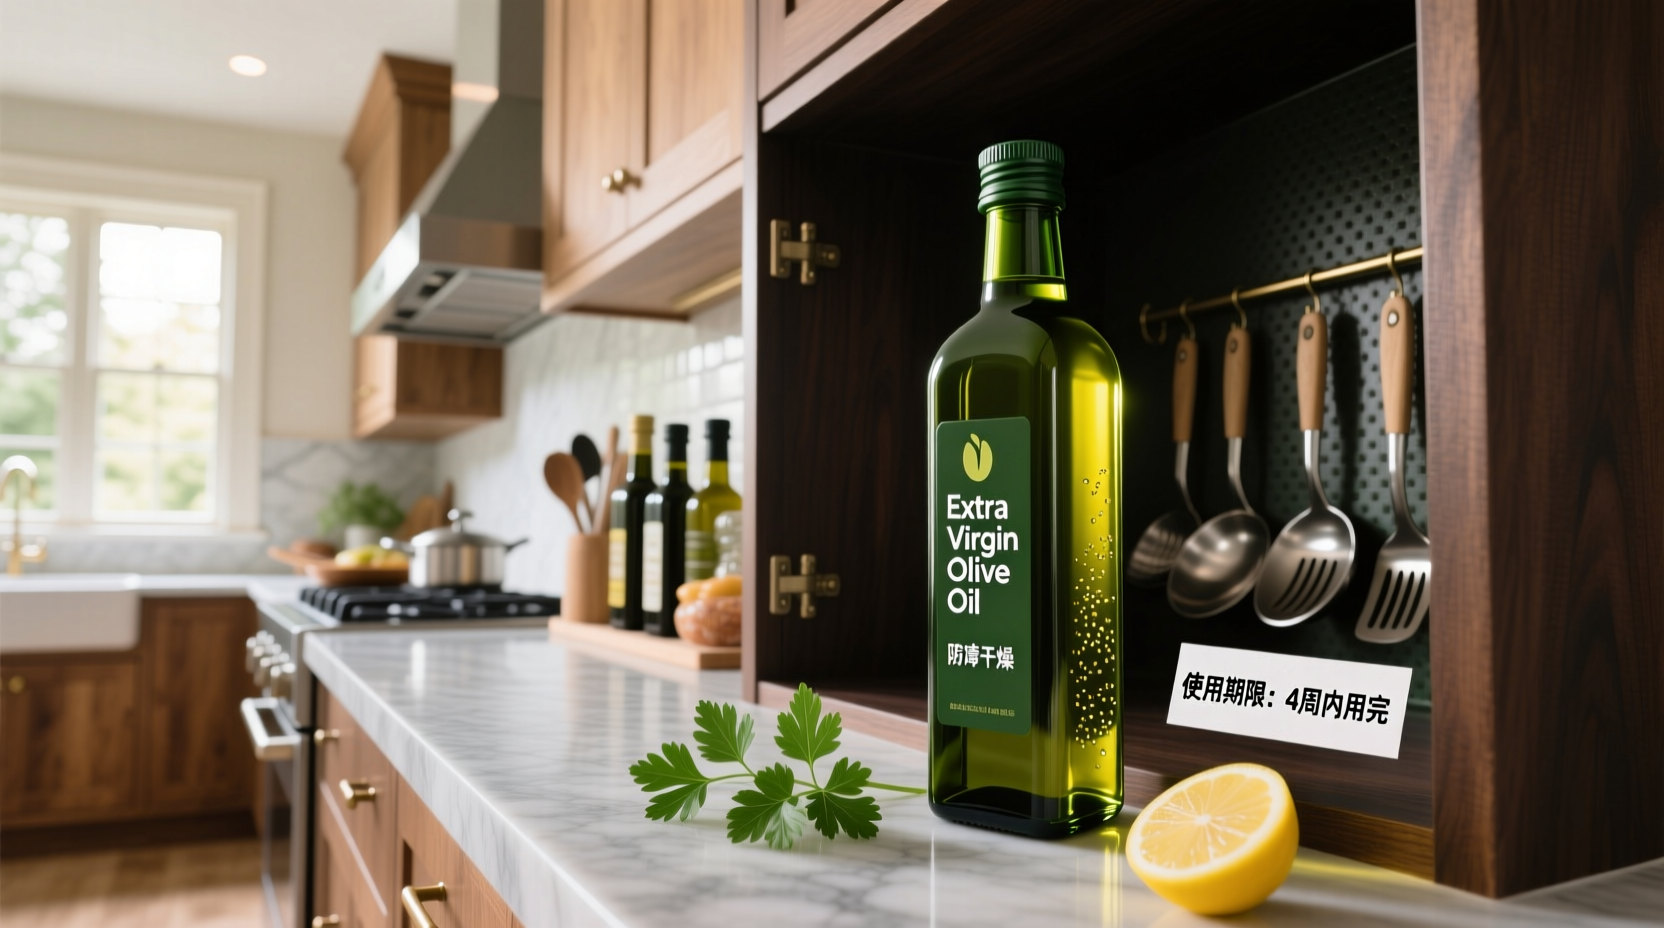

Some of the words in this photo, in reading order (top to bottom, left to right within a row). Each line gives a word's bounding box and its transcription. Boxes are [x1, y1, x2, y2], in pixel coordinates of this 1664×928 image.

[947, 493, 1009, 520] Extra
[946, 524, 1019, 559] Virgin
[946, 555, 1011, 585] Olive
[947, 587, 980, 615] Oil
